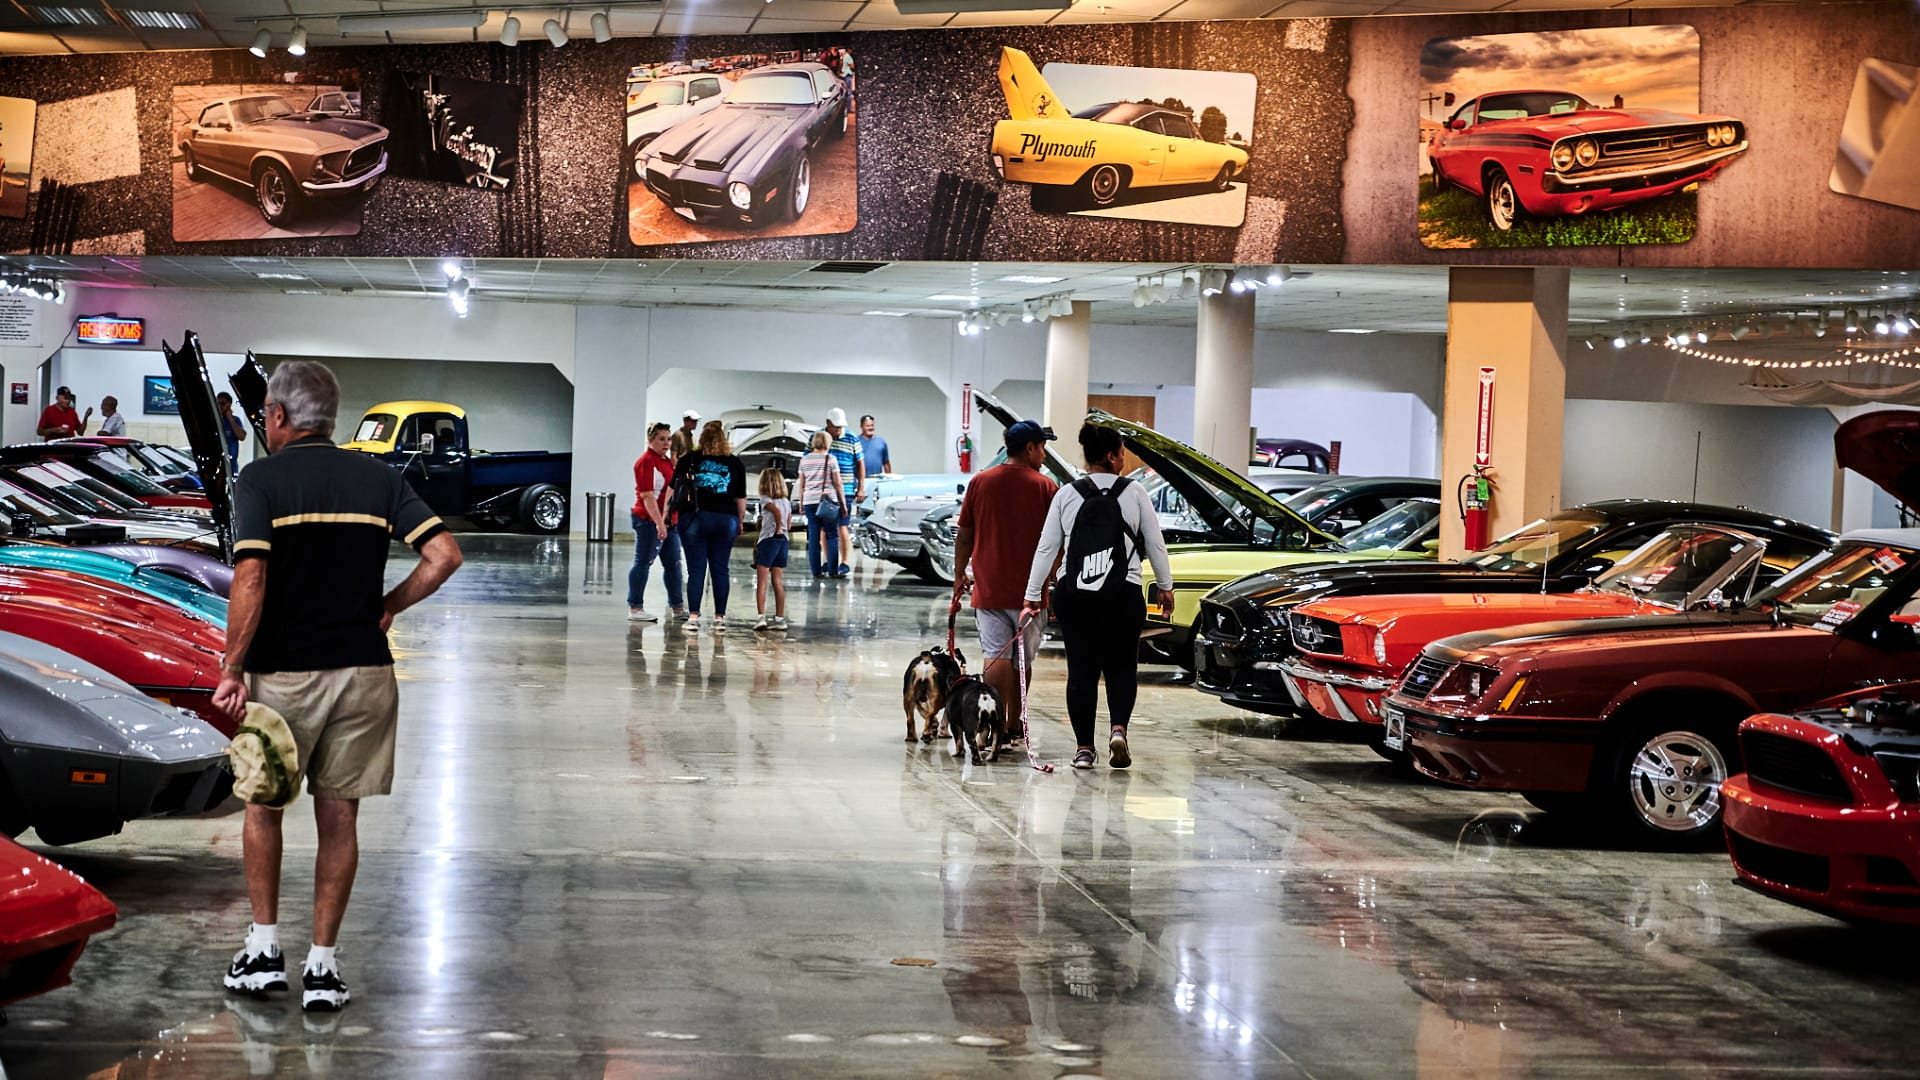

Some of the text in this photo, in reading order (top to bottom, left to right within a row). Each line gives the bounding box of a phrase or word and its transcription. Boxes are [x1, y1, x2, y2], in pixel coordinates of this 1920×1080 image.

[1020, 133, 1097, 162] Plymouth
[79, 322, 142, 339] REOOMS
[1082, 546, 1114, 580] NIK
